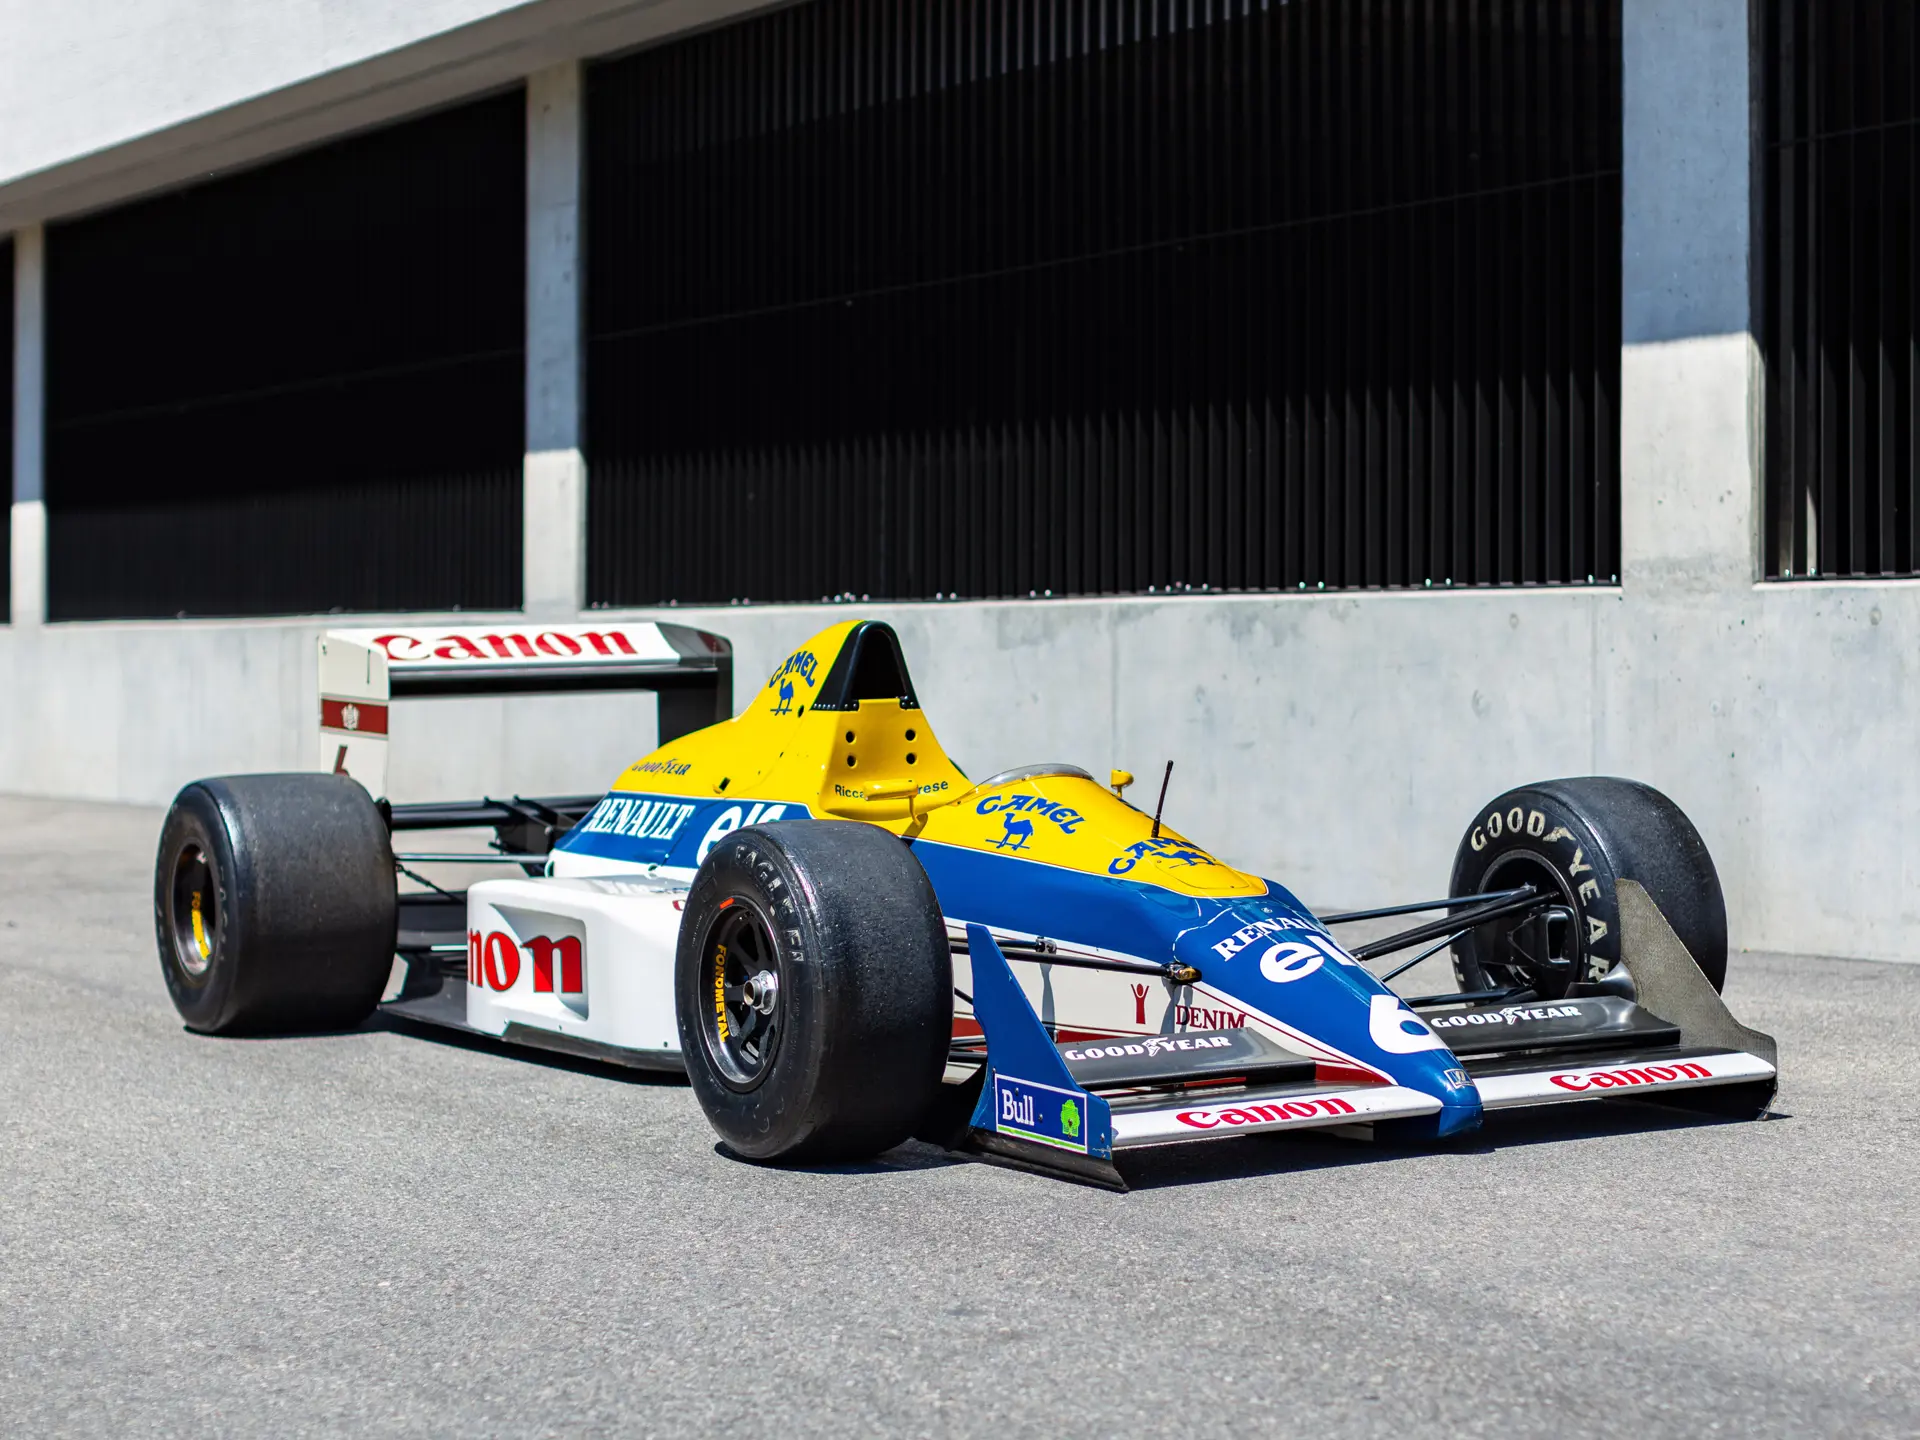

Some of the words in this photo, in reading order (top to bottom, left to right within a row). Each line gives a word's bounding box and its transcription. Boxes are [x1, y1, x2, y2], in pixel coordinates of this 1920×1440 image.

[372, 630, 638, 661] Canon
[769, 650, 818, 688] CAMEL
[835, 784, 865, 798] Ricca
[917, 780, 949, 794] rese
[583, 799, 696, 841] RENAULT
[975, 793, 1087, 835] CAMEL
[1211, 917, 1320, 962] RENA
[468, 928, 583, 994] non
[1260, 935, 1362, 984] el
[1175, 1004, 1247, 1030] DENIM
[1368, 995, 1451, 1055] 6
[1549, 1062, 1713, 1091] Canon
[1002, 1089, 1035, 1127] Bull
[1175, 1097, 1357, 1129] Canon
